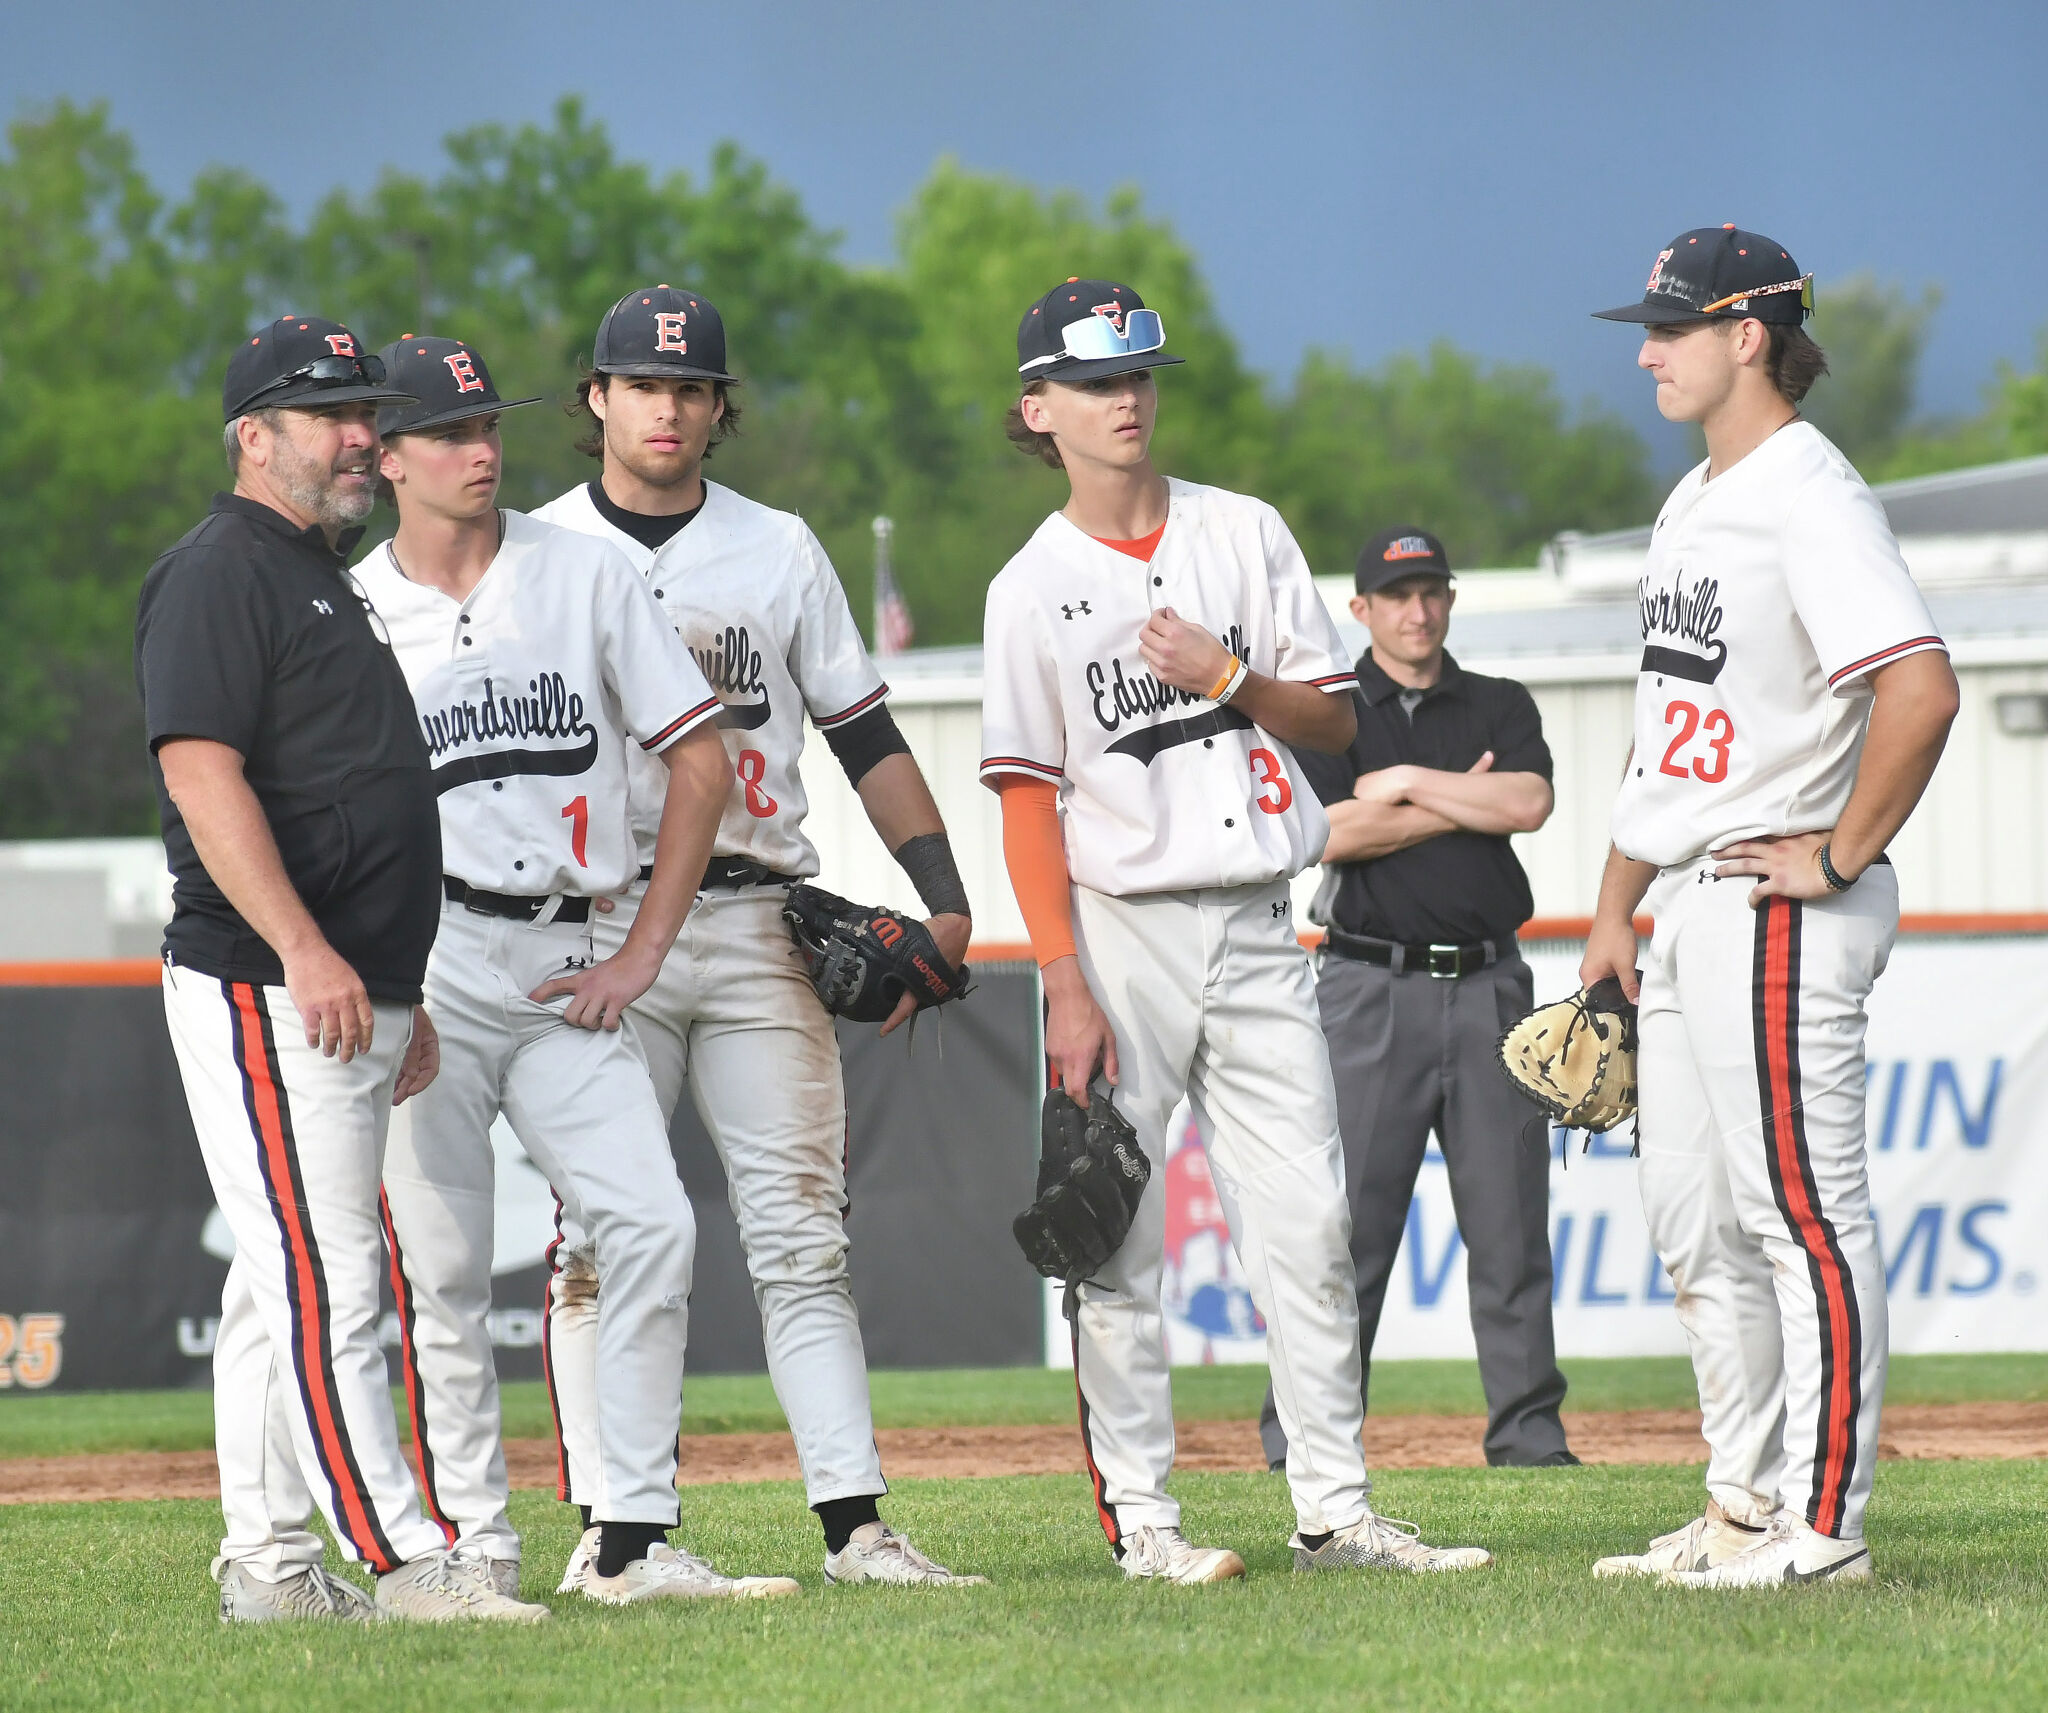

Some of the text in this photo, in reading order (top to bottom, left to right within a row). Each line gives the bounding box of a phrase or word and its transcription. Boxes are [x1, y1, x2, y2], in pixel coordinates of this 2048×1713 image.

[654, 311, 687, 355] E
[443, 350, 485, 394] E
[1659, 700, 1735, 784] 23
[737, 749, 778, 818] 8
[1249, 747, 1293, 815] 3
[561, 795, 588, 868] 1
[912, 953, 950, 998] Wilson
